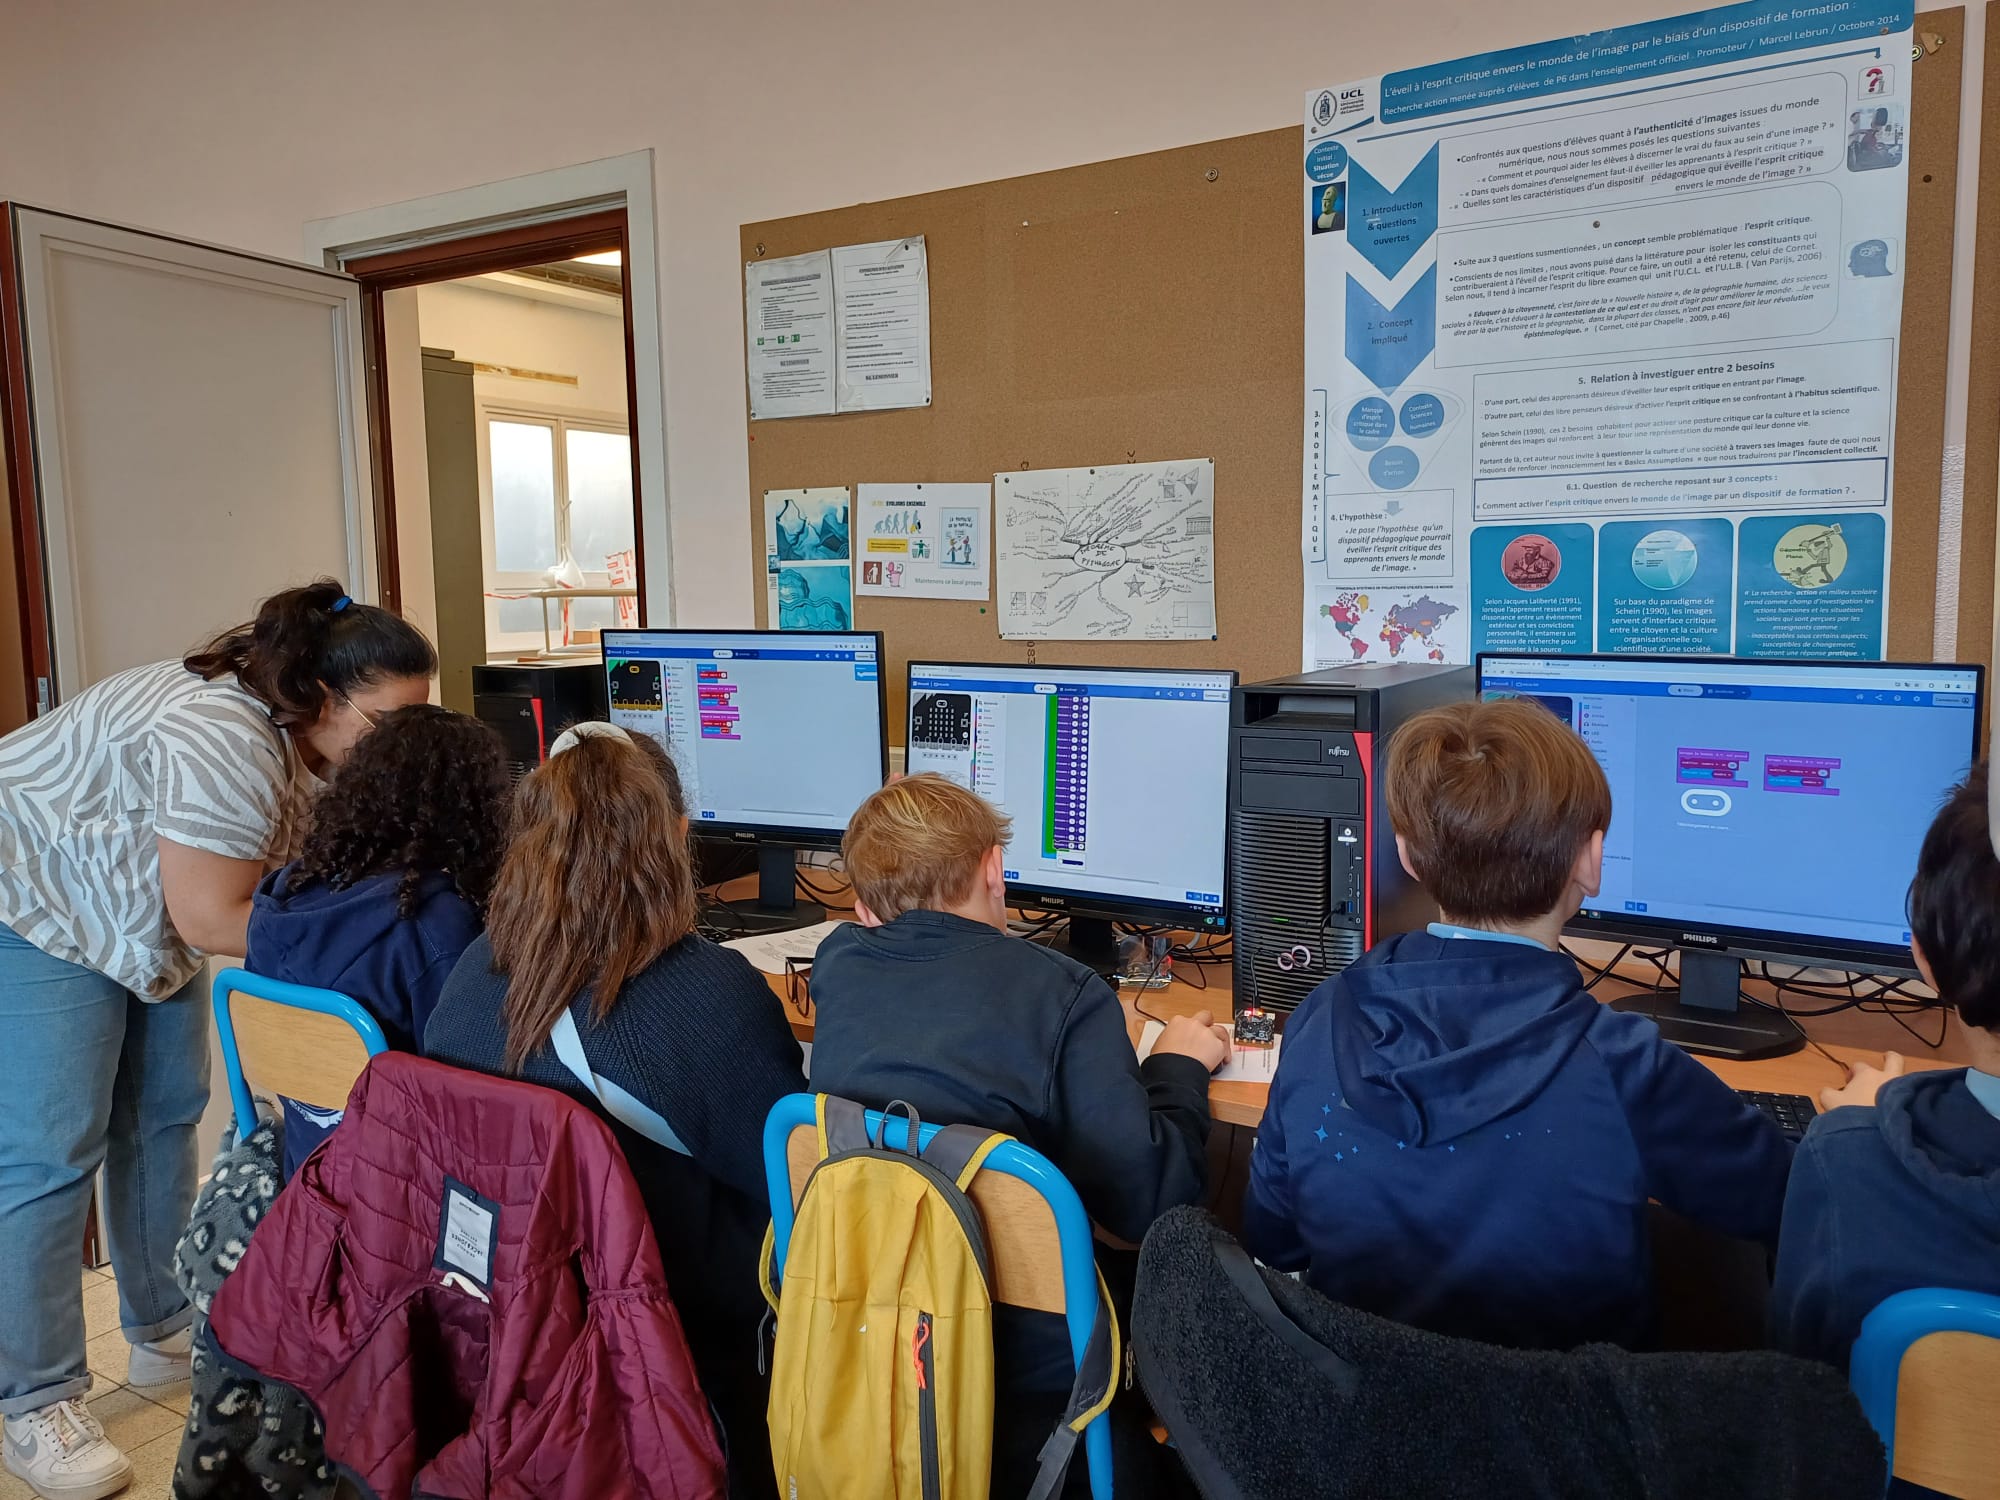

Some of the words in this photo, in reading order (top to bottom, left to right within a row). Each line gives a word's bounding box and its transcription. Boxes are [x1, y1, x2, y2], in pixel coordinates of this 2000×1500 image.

[1384, 81, 1412, 97] L'éveil
[1414, 80, 1419, 91] à
[1422, 75, 1451, 90] l'esprit
[1454, 70, 1490, 84] critique
[1492, 64, 1524, 77] envers
[1526, 59, 1535, 71] le
[1538, 53, 1573, 68] monde
[1575, 50, 1588, 61] de
[1591, 44, 1629, 58] l'image
[1631, 41, 1649, 54] par
[1652, 36, 1662, 47] le
[1664, 31, 1689, 45] biais
[1692, 27, 1716, 40] d'un
[1719, 15, 1769, 35] dispositif
[1773, 13, 1787, 24] de
[1791, 3, 1848, 21] formation
[1383, 100, 1422, 115] Recherche
[1424, 96, 1447, 108] action
[1448, 91, 1476, 104] menée
[1478, 85, 1505, 99] auprès
[1506, 81, 1539, 93] d'élèves
[1543, 77, 1554, 87] de
[1556, 73, 1567, 84] P6
[1568, 72, 1588, 82] dans
[1591, 58, 1656, 78] l'enseignement
[1658, 51, 1689, 66] officiel
[1696, 43, 1746, 59] Promoteur
[1759, 32, 1792, 47] Marcel
[1794, 29, 1828, 41] Lebrun
[1838, 19, 1874, 33] Octobre
[1877, 13, 1899, 26] 2014
[1341, 88, 1364, 100] UCL
[1457, 149, 1503, 164] Confrontés
[1505, 148, 1520, 156] aux
[1521, 141, 1561, 156] questions
[1563, 135, 1597, 147] d'élèves
[1599, 129, 1624, 143] quant
[1626, 128, 1631, 136] à
[1633, 118, 1693, 135] l'authenticité
[1695, 113, 1737, 125] d'images
[1739, 108, 1767, 118] issues
[1770, 104, 1782, 113] du
[1785, 98, 1819, 111] monde
[1498, 157, 1544, 170] numérique,
[1547, 153, 1567, 162] nous
[1569, 150, 1589, 158] nous
[1591, 143, 1627, 155] sommes
[1629, 137, 1654, 151] posés
[1656, 136, 1669, 144] les
[1671, 129, 1714, 144] questions
[1717, 122, 1760, 135] suivantes
[1314, 163, 1339, 171] Situation
[1675, 182, 1703, 192] envers
[1705, 178, 1713, 187] le
[1715, 174, 1746, 186] monde
[1747, 172, 1760, 181] de
[1761, 168, 1795, 179] l'image
[1371, 201, 1422, 215] Introduction
[1368, 223, 1376, 231] &
[1377, 218, 1416, 231] questions
[1374, 234, 1409, 245] ouvertes
[1378, 318, 1413, 330] Concept
[1371, 334, 1407, 346] impliqué
[1578, 374, 1585, 384] 5.
[1590, 372, 1629, 383] Relation
[1632, 370, 1638, 380] à
[1640, 367, 1694, 379] investiguer
[1697, 365, 1724, 375] entre
[1726, 363, 1732, 373] 2
[1735, 361, 1774, 372] besoins
[1566, 481, 1580, 490] 6.1.
[1582, 480, 1617, 491] Question
[1621, 479, 1631, 488] de
[1633, 478, 1672, 487] recherche
[1674, 476, 1710, 487] reposant
[1728, 475, 1732, 483] 3
[1734, 474, 1772, 484] concepts
[1482, 501, 1517, 510] Comment
[1518, 500, 1543, 508] activer
[1545, 498, 1571, 509] l'esprit
[1572, 497, 1602, 508] critique
[1631, 495, 1638, 504] le
[1640, 494, 1668, 503] monde
[1670, 493, 1680, 502] de
[1683, 493, 1712, 503] l'image
[1713, 494, 1727, 502] par
[1742, 489, 1781, 501] dispositif
[1785, 489, 1796, 497] de
[1798, 487, 1842, 497] formation
[1339, 511, 1382, 523] L'hypothèse
[1348, 526, 1358, 535] Je
[1357, 528, 1375, 536] pose
[1376, 524, 1418, 535] l'hypothèse
[1421, 523, 1443, 534] qu'un
[1337, 535, 1370, 547] dispositif
[1371, 534, 1418, 546] pédagogique
[1420, 532, 1451, 544] pourrait
[1346, 545, 1371, 554] éveiller
[1373, 544, 1397, 555] l'esprit
[1399, 544, 1427, 554] critique
[1428, 543, 1441, 552] des
[1343, 555, 1383, 566] apprenants
[1410, 553, 1417, 562] le
[1419, 552, 1445, 561] monde
[1370, 563, 1380, 572] de
[1381, 563, 1410, 574] l'image.
[1328, 746, 1349, 756] FUJITSU
[1041, 896, 1064, 905] PHILIPS
[1682, 934, 1717, 943] PHILIPS
